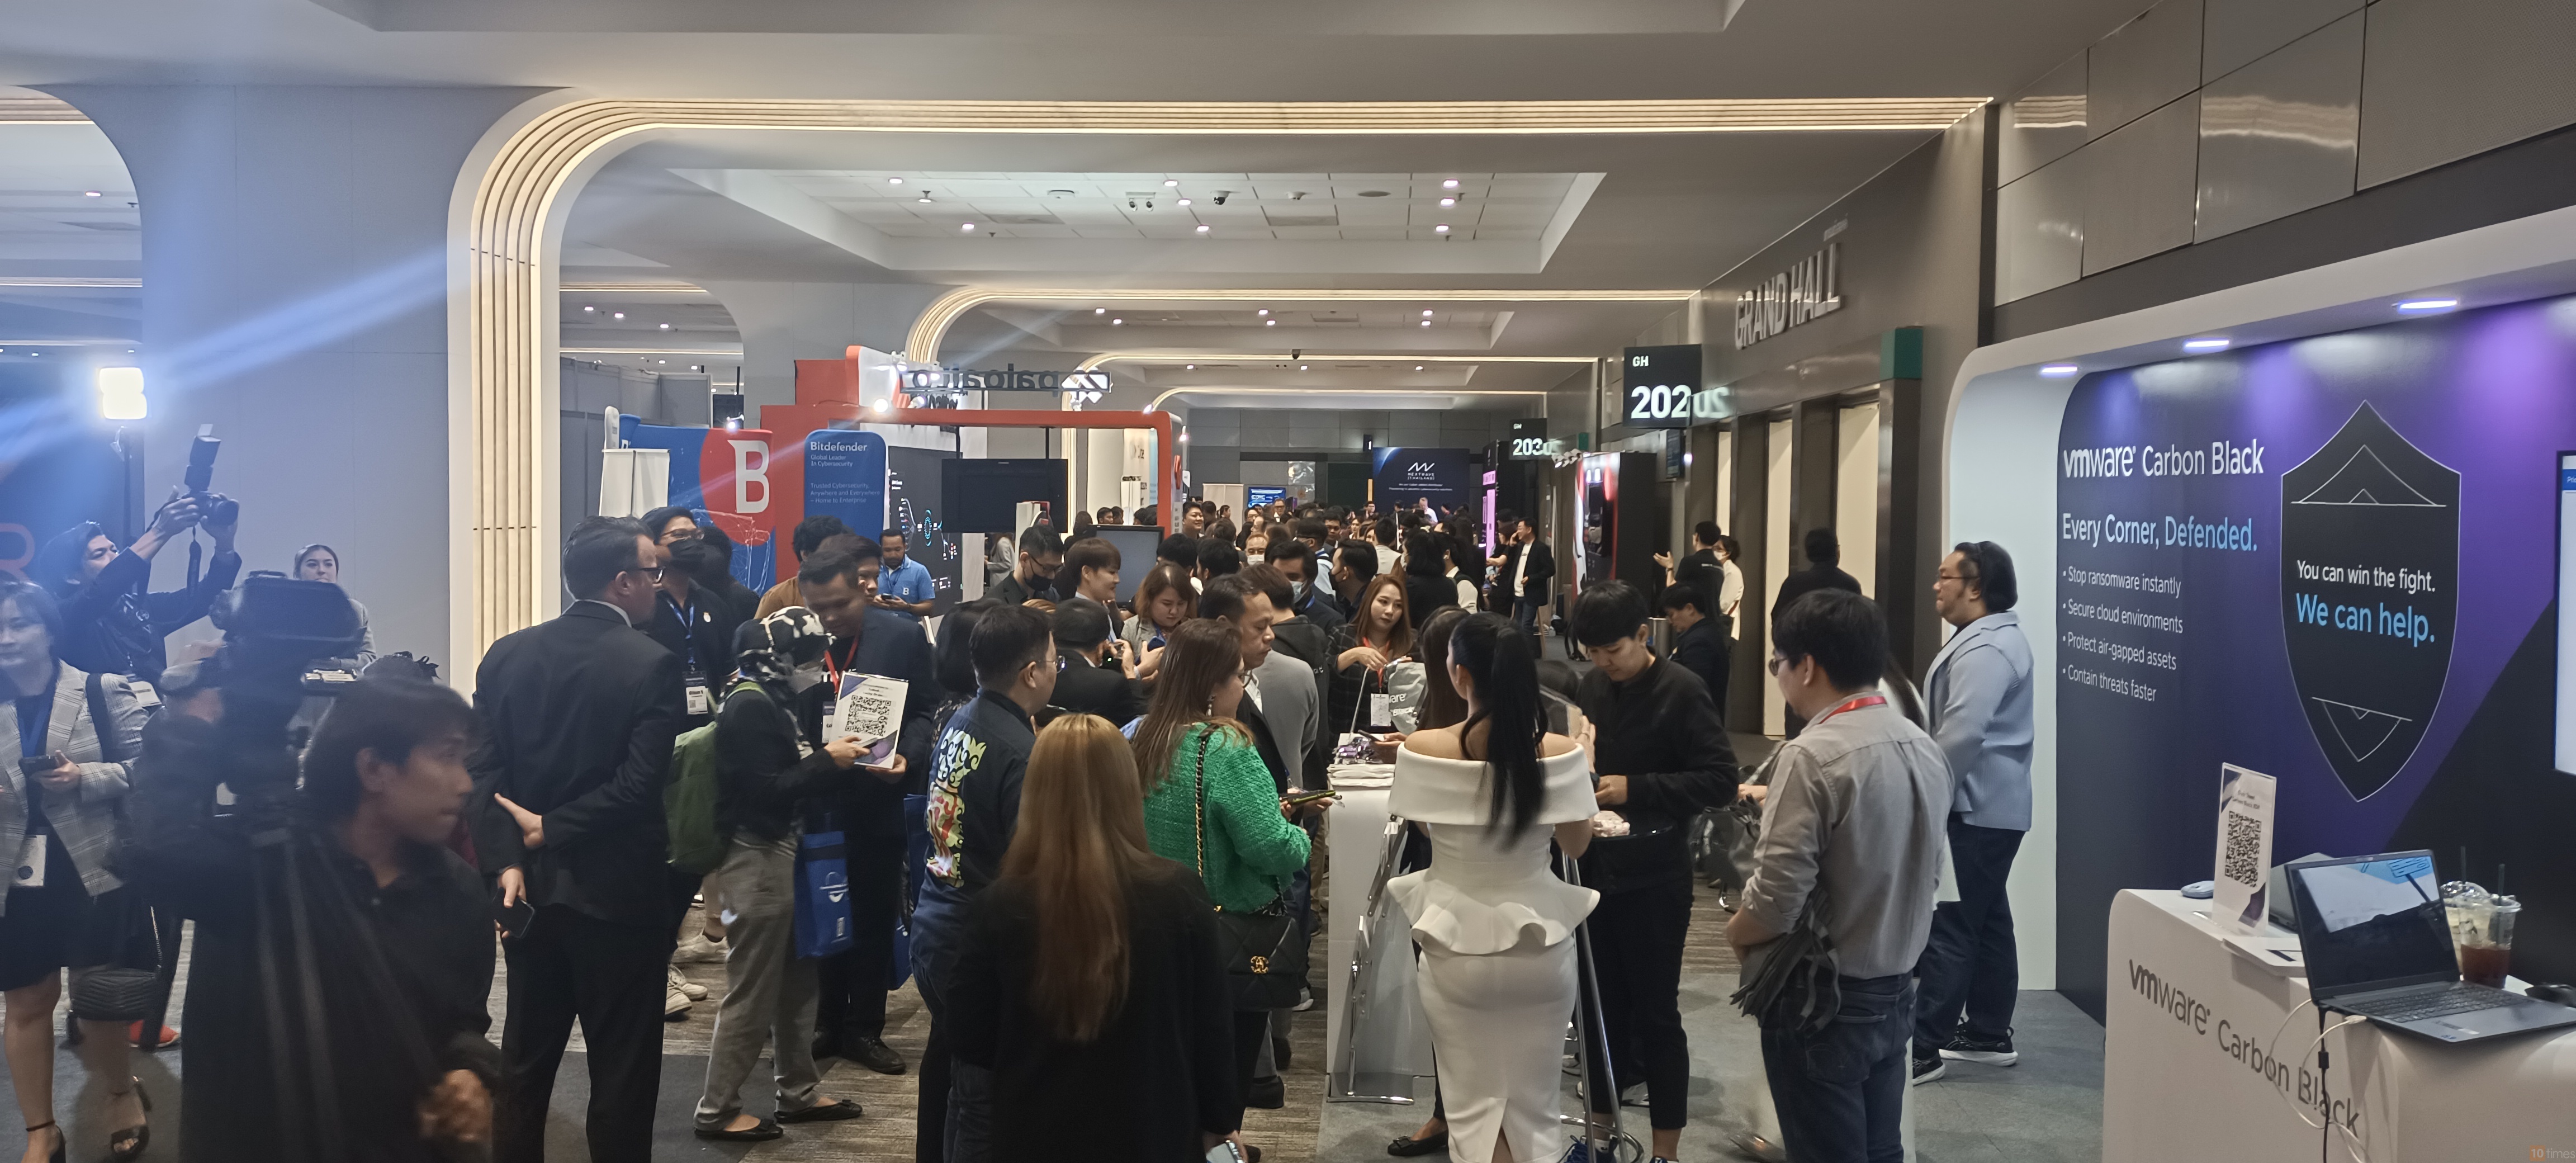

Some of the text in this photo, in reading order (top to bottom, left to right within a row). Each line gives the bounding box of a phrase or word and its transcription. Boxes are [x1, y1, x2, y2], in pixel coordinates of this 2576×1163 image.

[1735, 243, 1841, 349] GRAND HALL
[1632, 356, 1649, 367] GH
[1631, 385, 1692, 419] 202
[811, 441, 868, 451] Bitdefender
[1513, 438, 1543, 456] 203
[2143, 444, 2205, 476] Carbon
[2212, 438, 2265, 475] Black
[2063, 513, 2257, 551] Every Corner, Defended.
[2068, 566, 2181, 599] Stop ransomware instantly
[2297, 560, 2435, 594] You can win the fight.
[2068, 598, 2184, 633] Secure cloud environments
[2296, 593, 2435, 647] We can help.
[2068, 632, 2177, 670] Protect air-gapped assets
[2068, 664, 2157, 701] Contain threats faster
[2218, 1019, 2289, 1091] Carbon
[2298, 1066, 2359, 1138] Black
